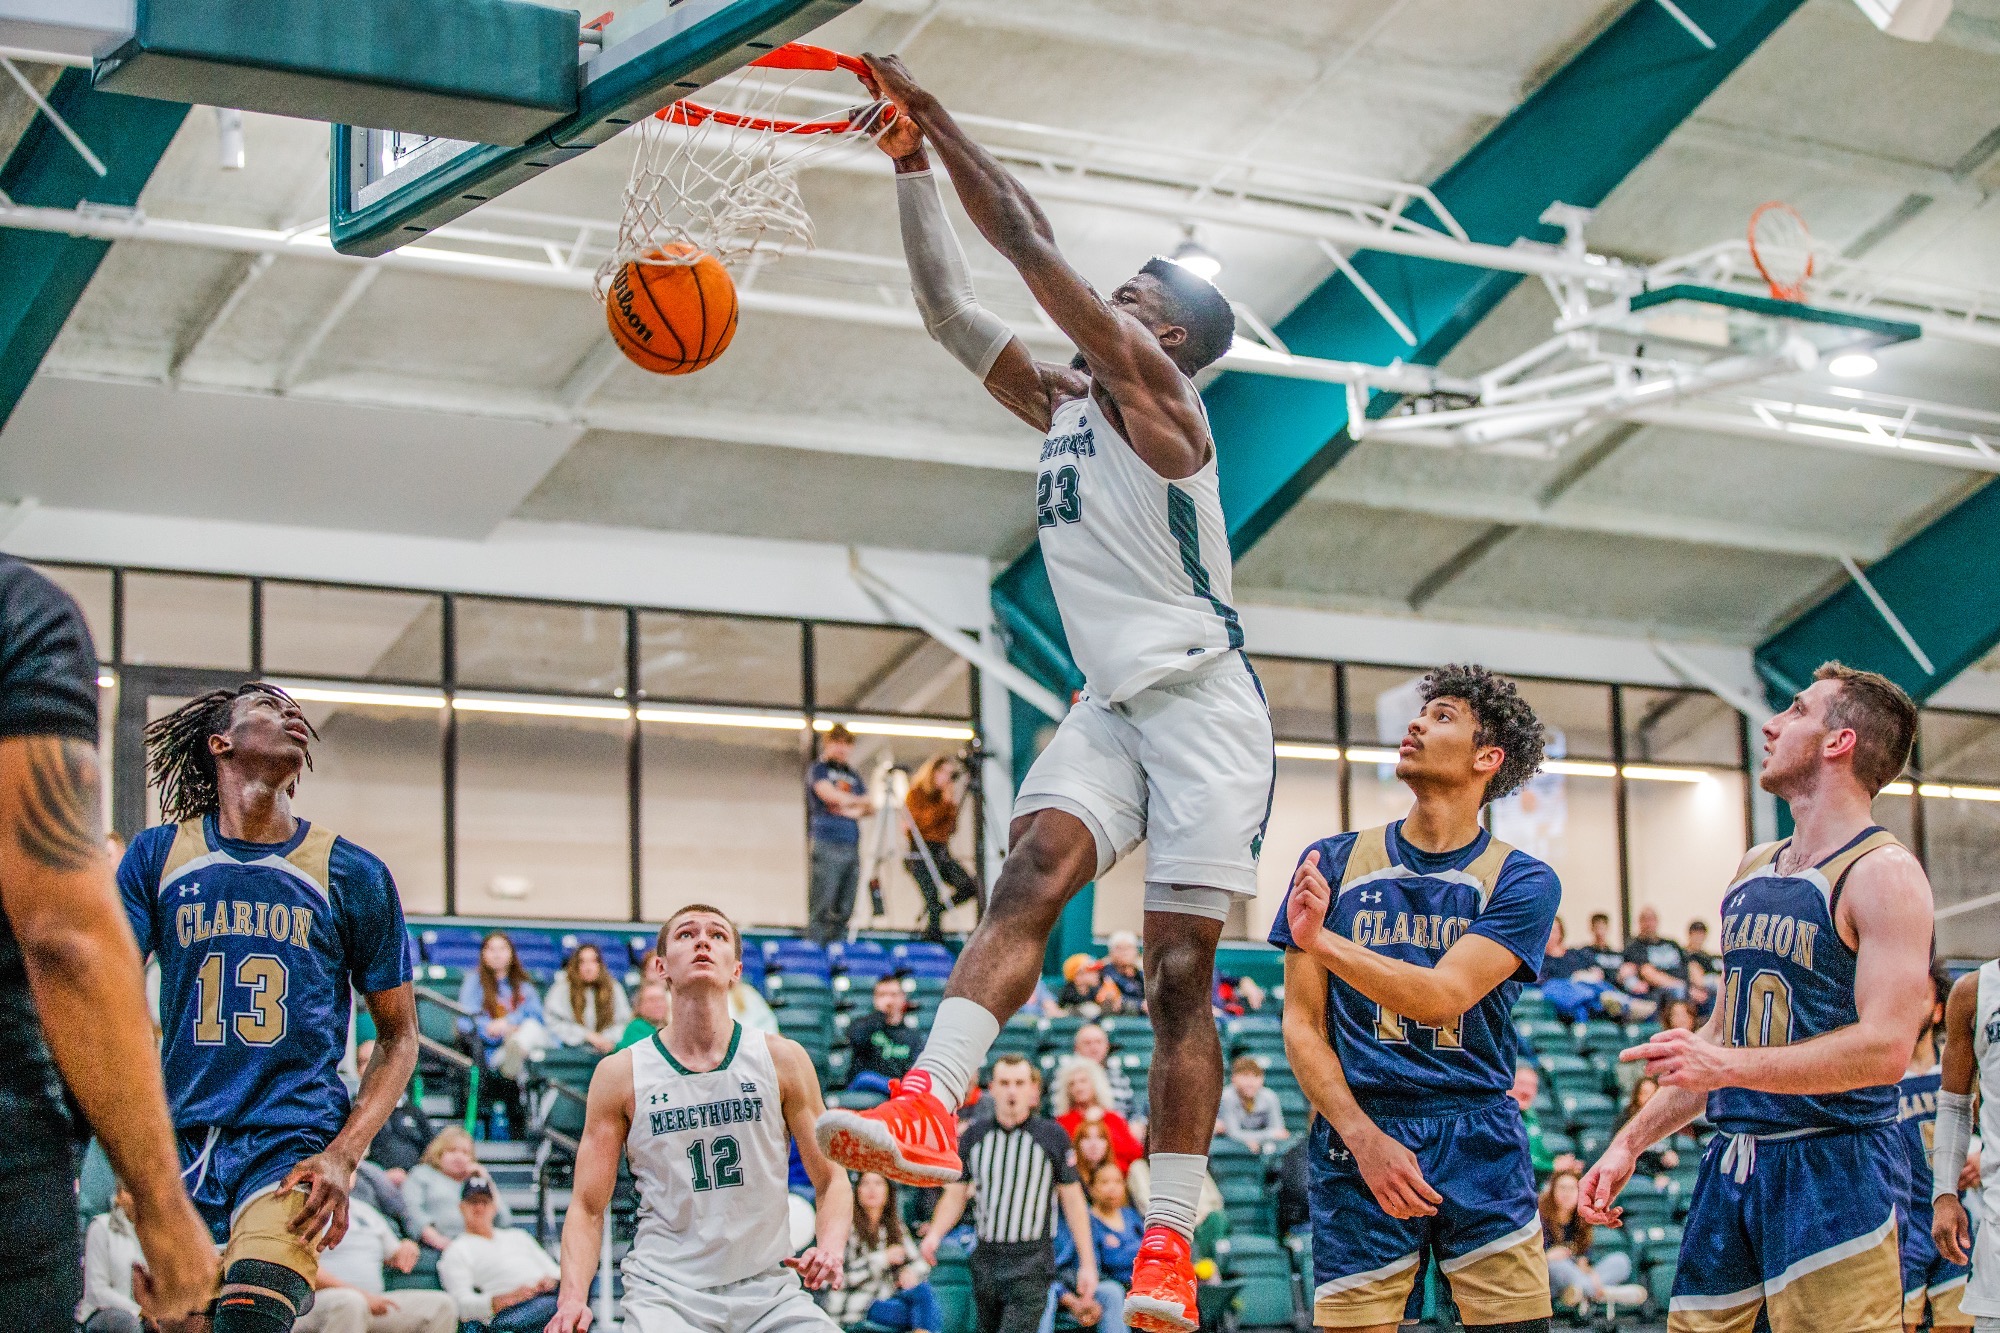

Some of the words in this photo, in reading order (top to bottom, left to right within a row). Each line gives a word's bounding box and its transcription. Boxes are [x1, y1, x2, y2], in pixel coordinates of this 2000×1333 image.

[1038, 464, 1081, 529] 23
[176, 900, 313, 949] CLARION
[1722, 913, 1818, 970] LARION
[193, 952, 289, 1047] 13
[1723, 966, 1793, 1048] 10
[649, 1097, 763, 1136] MERCYHURST
[686, 1134, 744, 1192] 12
